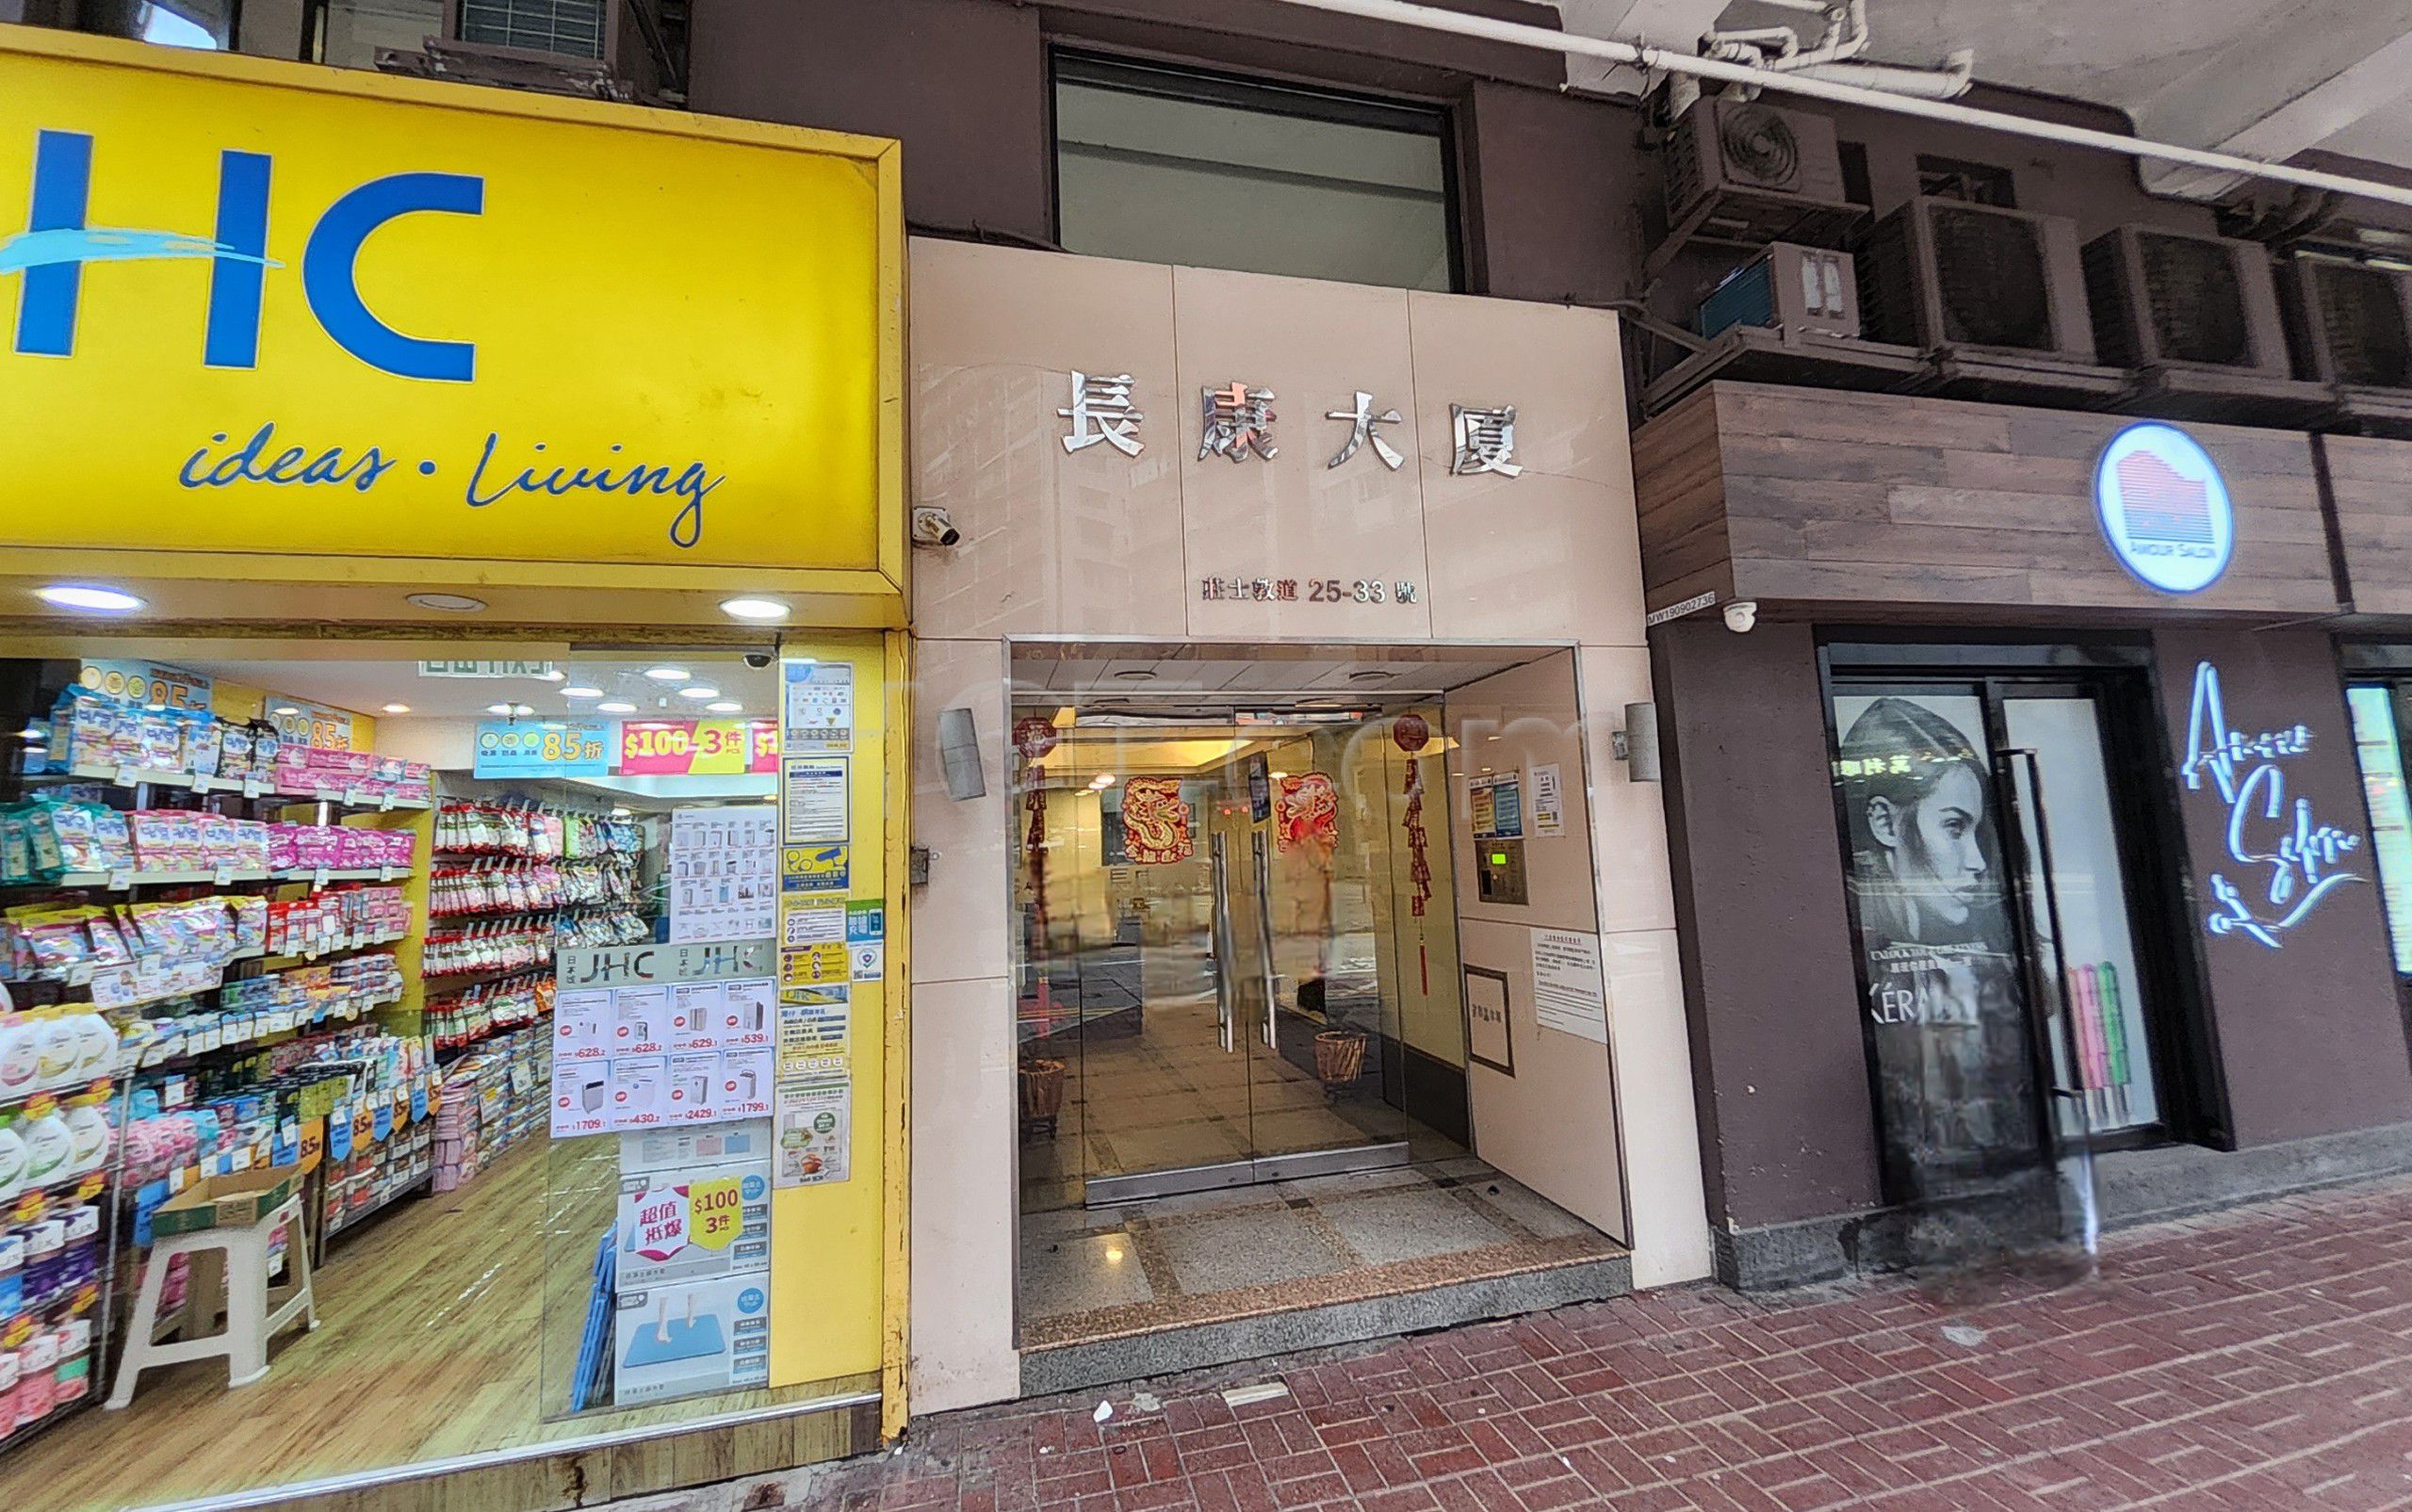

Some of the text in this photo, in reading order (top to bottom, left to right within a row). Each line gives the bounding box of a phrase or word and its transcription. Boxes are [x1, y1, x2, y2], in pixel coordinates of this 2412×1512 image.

[1057, 369, 1524, 479] 長康大廈
[179, 420, 726, 549] ideas Living
[1202, 577, 1299, 601] 莊士敦道
[1308, 577, 1386, 604] 25-33
[580, 950, 654, 984] JHC
[639, 1200, 677, 1227] 超值
[694, 1188, 739, 1215] $100
